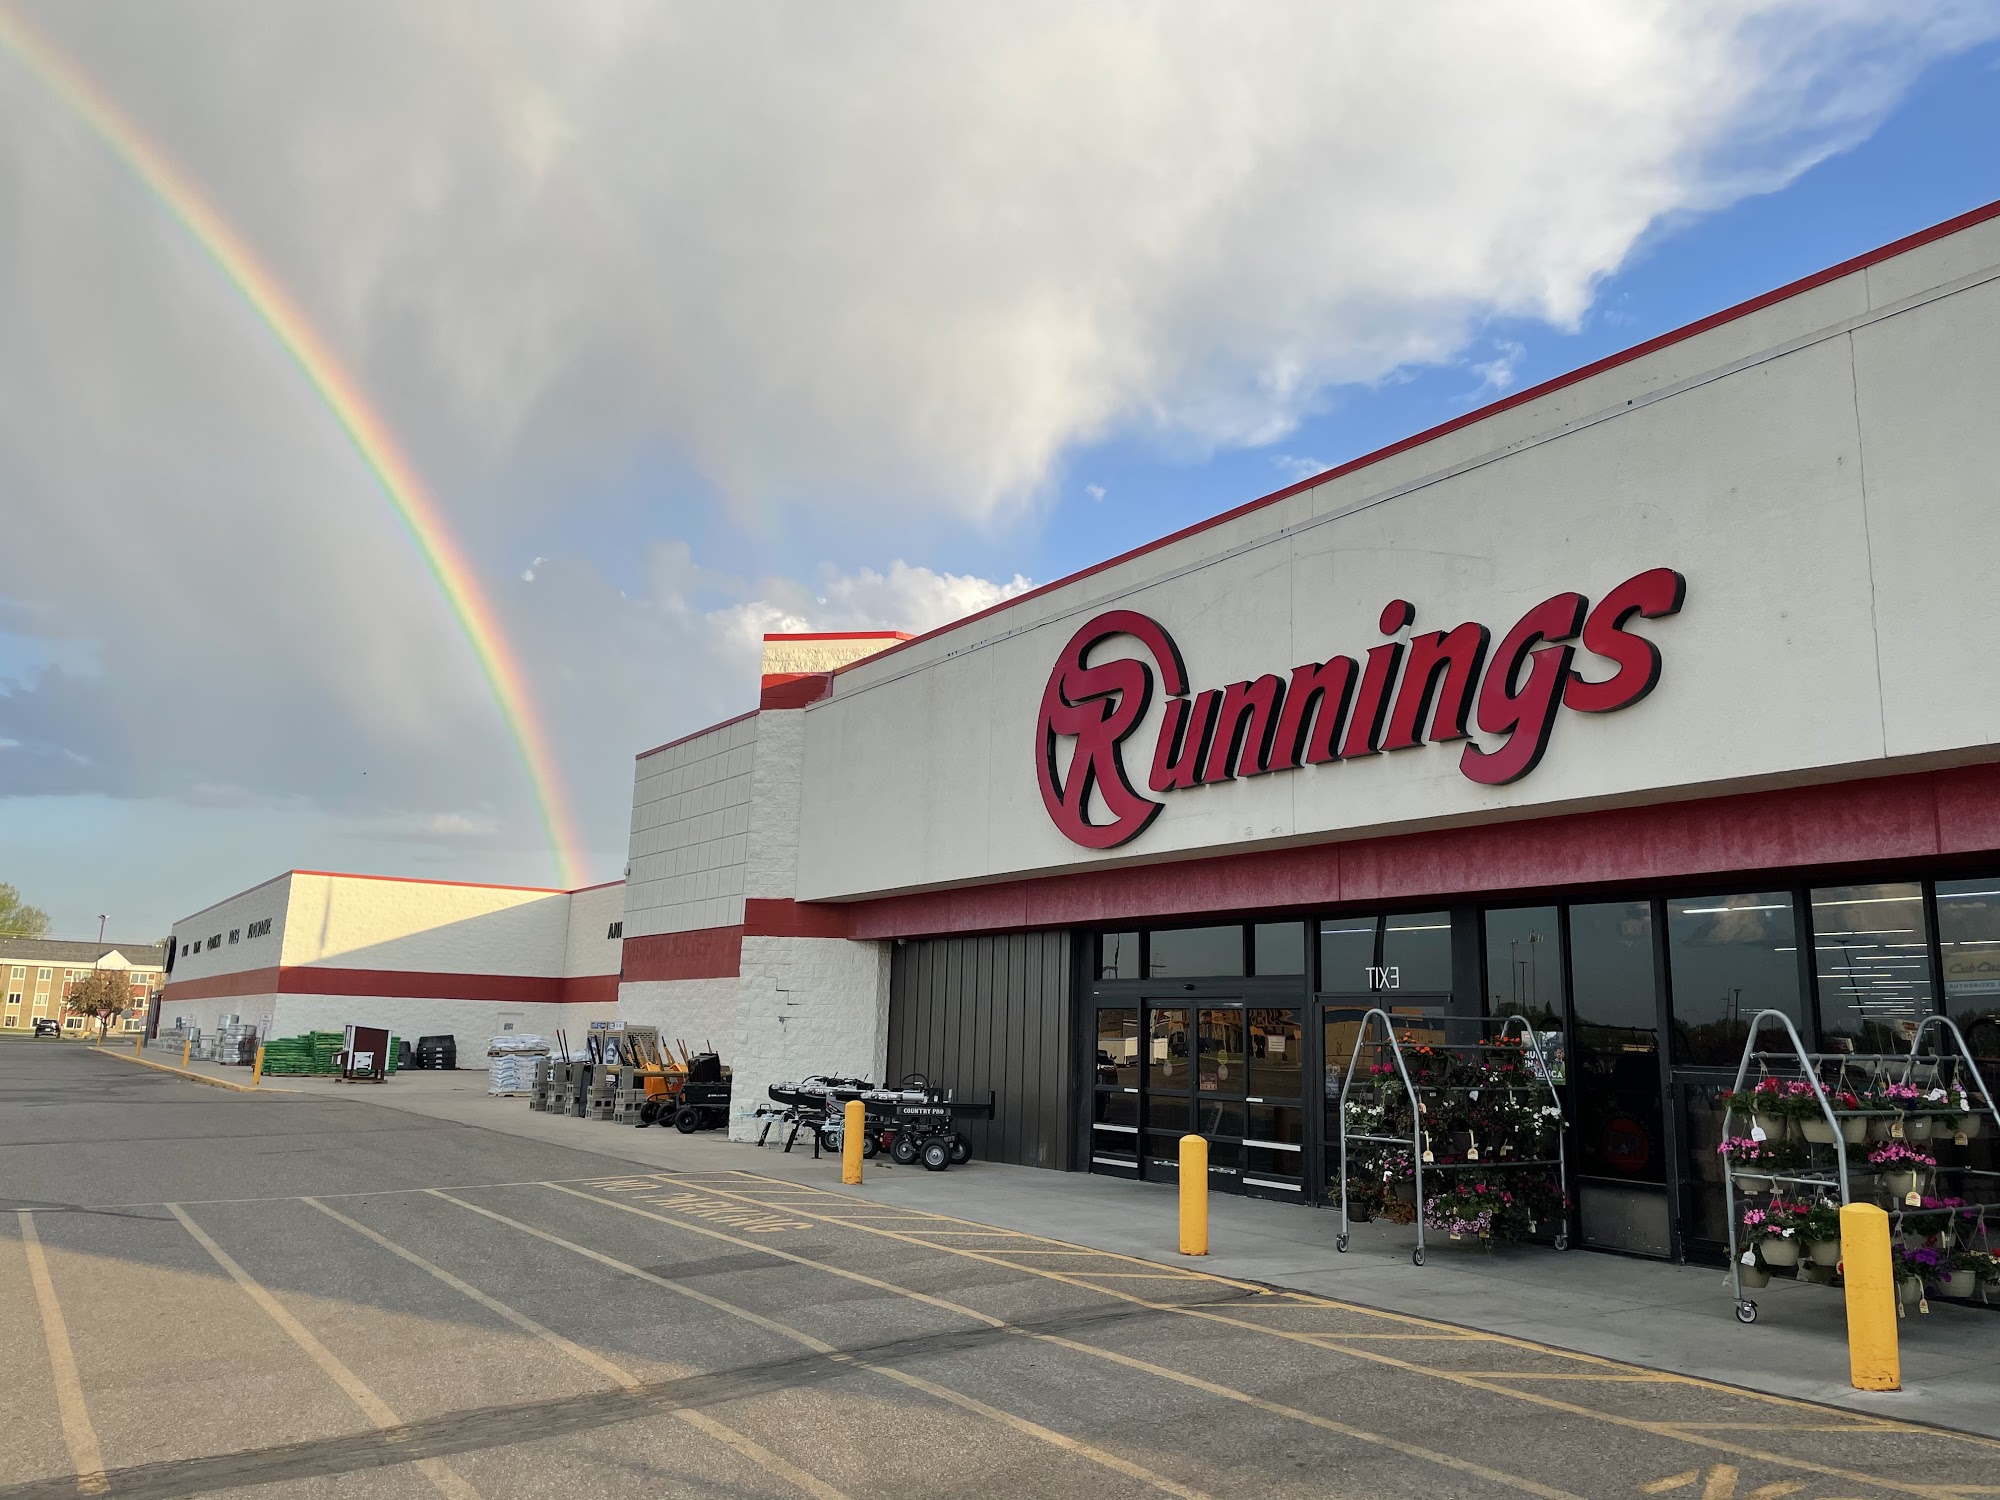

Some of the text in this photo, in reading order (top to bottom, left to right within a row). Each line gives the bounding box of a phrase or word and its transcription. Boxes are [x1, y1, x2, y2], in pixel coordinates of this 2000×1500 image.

[1035, 567, 1686, 848] Runnings
[1949, 981, 1996, 989] AUTHORIZED
[631, 1192, 814, 1233] PARKING
